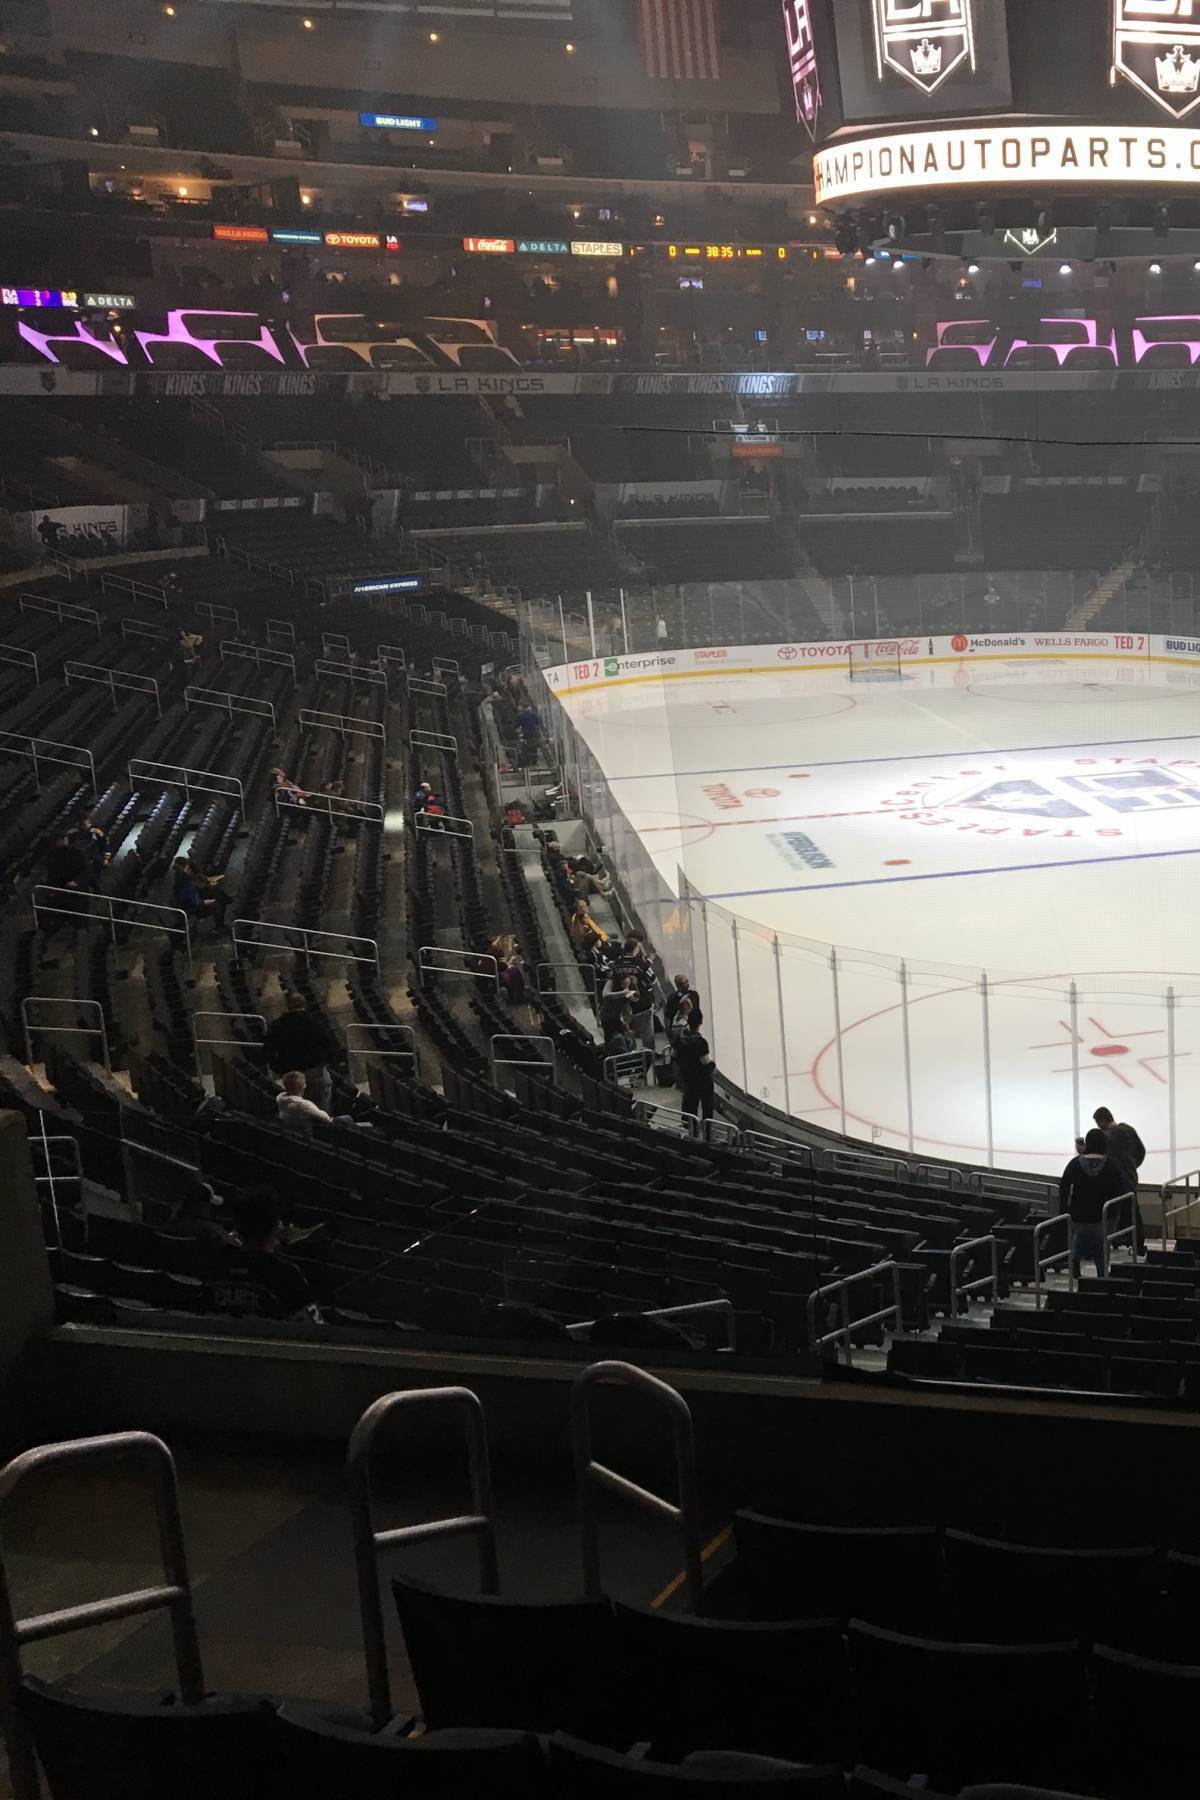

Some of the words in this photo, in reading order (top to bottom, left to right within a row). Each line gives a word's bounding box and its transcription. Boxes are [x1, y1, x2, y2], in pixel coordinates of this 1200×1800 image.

[375, 117, 394, 125] BUD
[395, 118, 421, 128] LIGHT
[341, 234, 378, 245] TOYOTA
[532, 243, 569, 251] DELTA
[572, 243, 622, 255] STAPLES
[706, 246, 734, 258] 38:35
[97, 297, 133, 307] DELTA
[166, 375, 206, 395] KINGS
[224, 375, 263, 395] KINGS
[278, 375, 316, 395] KINGS
[438, 378, 468, 391] LA
[479, 378, 545, 391] KINGS
[636, 376, 672, 394] KINGS
[688, 376, 723, 394] KINGS
[738, 375, 775, 394] KINGS
[946, 377, 1005, 389] KINGS
[73, 522, 118, 540] KINGS
[354, 584, 389, 592] AMERICAN
[970, 637, 1026, 649] McDonald's
[1033, 638, 1073, 648] WELLS
[1075, 638, 1108, 648] FARGO
[1113, 636, 1134, 650] TED
[1166, 641, 1186, 651] BUD
[694, 650, 728, 659] STAPLES
[800, 645, 854, 658] TOYOTA
[605, 656, 676, 672] enterprise
[573, 664, 590, 680] TED
[699, 783, 744, 810] TOYOTA
